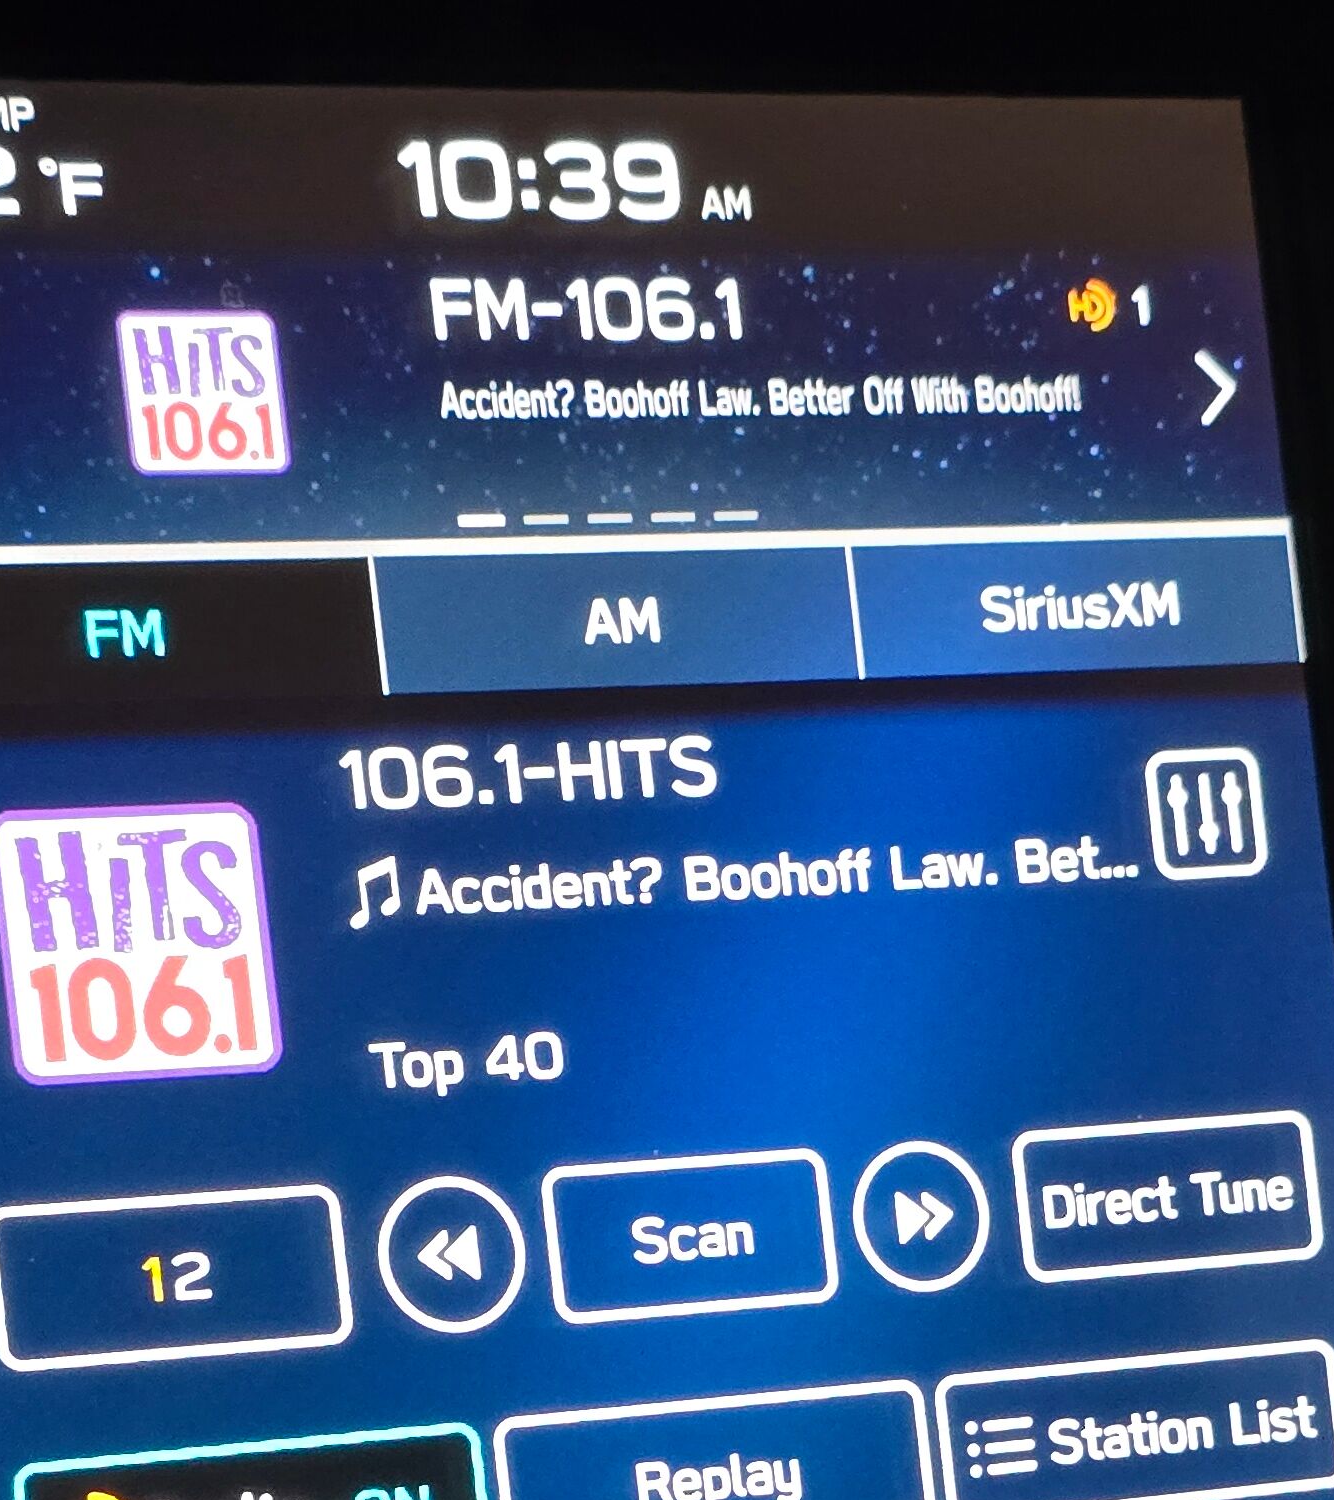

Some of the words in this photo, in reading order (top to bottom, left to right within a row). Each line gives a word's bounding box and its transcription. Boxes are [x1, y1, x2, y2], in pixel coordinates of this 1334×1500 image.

[397, 139, 681, 221] 10:39
[701, 186, 752, 221] AM
[429, 276, 743, 342] FM-106.1
[1131, 285, 1151, 326] 1
[440, 378, 575, 420] Accident?
[583, 379, 690, 419] Boohoff
[697, 379, 761, 417] Law.
[767, 377, 855, 417] Better
[863, 375, 904, 416] Off
[910, 376, 969, 414] With
[974, 374, 1082, 414] Boohoff!
[139, 400, 275, 462] 106.1
[83, 608, 166, 659] FM
[584, 596, 661, 645] AM
[980, 580, 1181, 633] SiriusXM
[338, 734, 717, 810] 106.1-HITS
[415, 856, 663, 915] Accident?
[683, 847, 872, 902] Boohoff
[889, 845, 999, 891] Law.
[1014, 835, 1139, 884] Bet...
[29, 954, 257, 1062] 106.1
[367, 1041, 465, 1097] Top
[485, 1031, 564, 1081] 40
[1042, 1175, 1179, 1229] Direct
[1189, 1171, 1294, 1216] Tune
[631, 1215, 755, 1265] Scan
[141, 1251, 214, 1303] 12
[1047, 1410, 1215, 1465] Station
[1228, 1395, 1319, 1446] List
